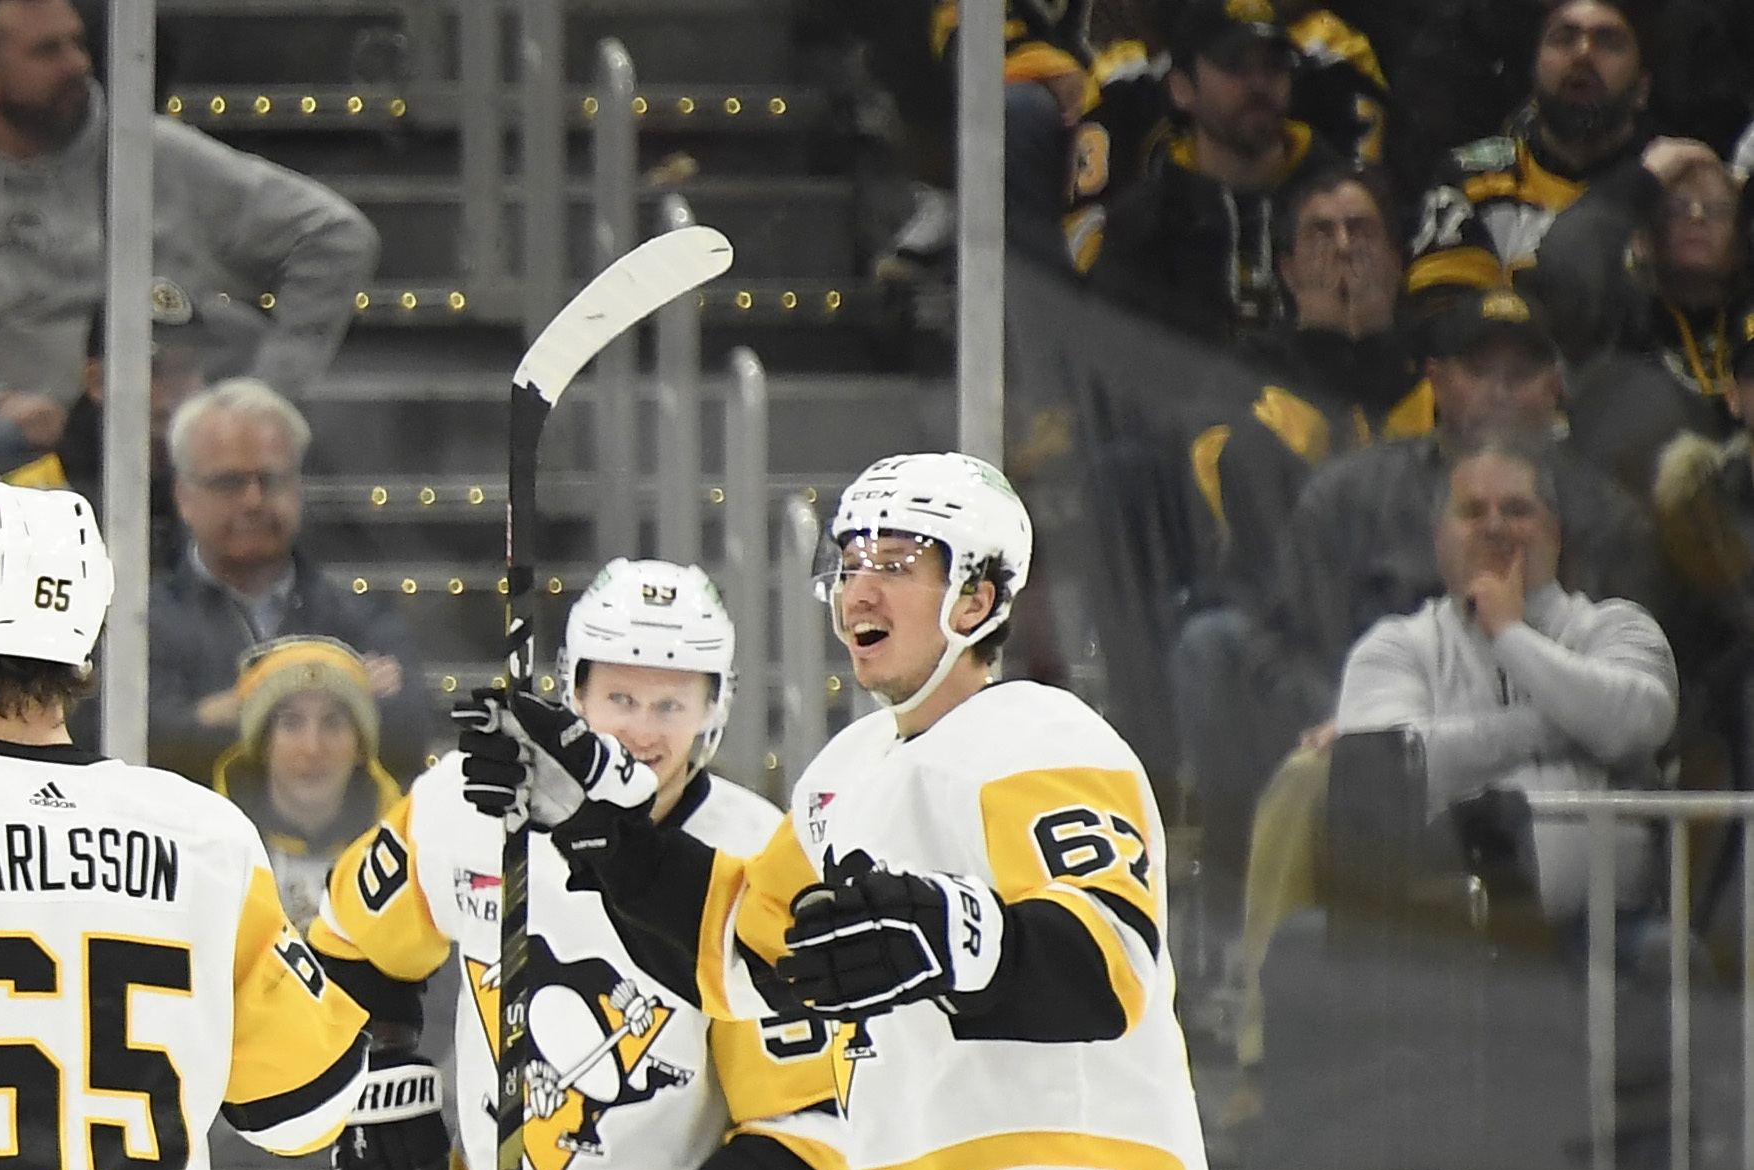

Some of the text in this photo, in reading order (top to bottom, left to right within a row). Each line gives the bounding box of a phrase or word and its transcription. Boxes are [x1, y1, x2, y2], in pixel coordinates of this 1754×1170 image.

[34, 575, 73, 612] 65
[28, 798, 77, 809] adidas
[352, 1076, 435, 1111] RIOR
